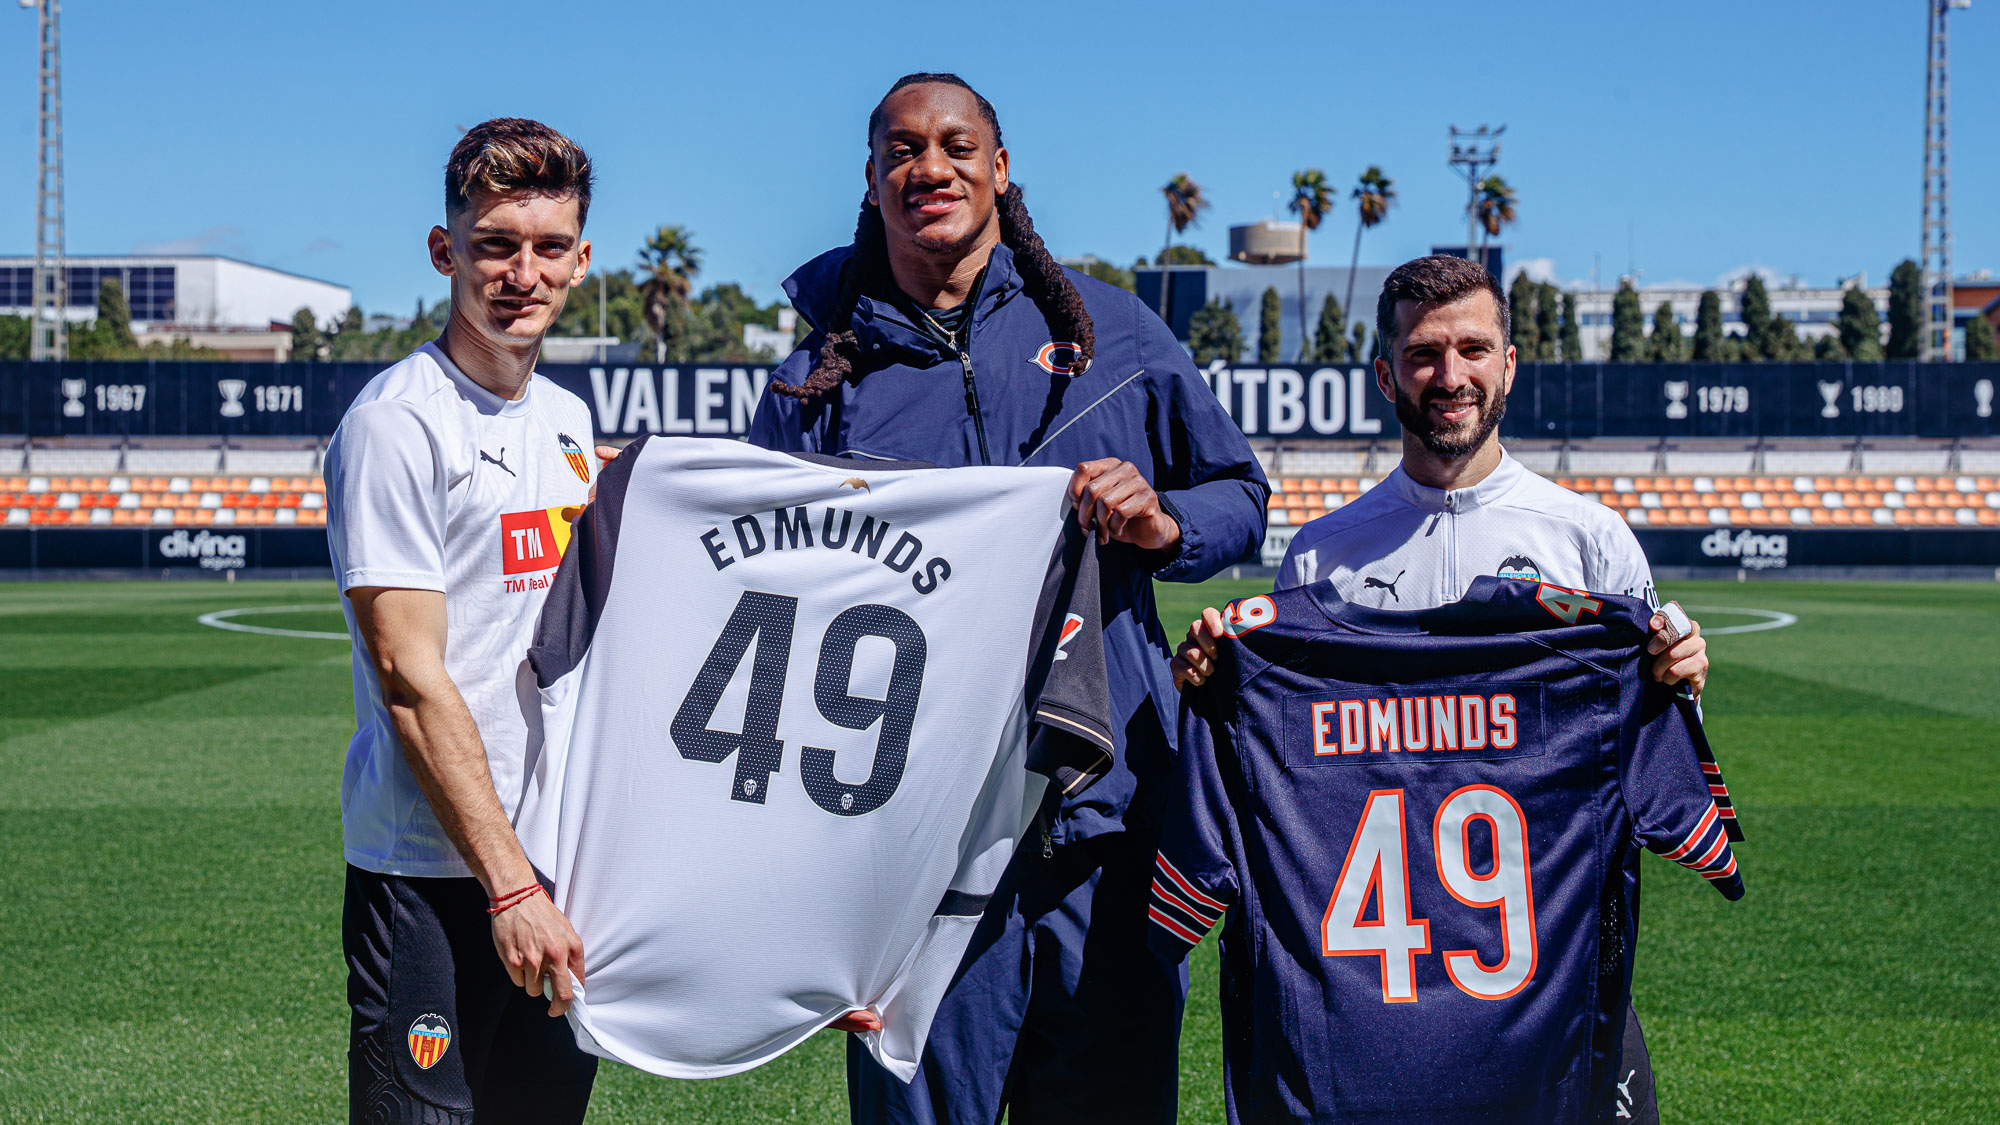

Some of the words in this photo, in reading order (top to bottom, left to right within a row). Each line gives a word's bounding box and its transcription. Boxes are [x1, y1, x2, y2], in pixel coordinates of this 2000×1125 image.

[95, 385, 146, 411] 1967
[254, 385, 302, 412] 1971
[1697, 386, 1749, 412] 1979
[159, 529, 246, 558] divina
[510, 527, 545, 561] TM
[699, 506, 952, 595] EDMUNDS
[1701, 528, 1788, 557] divina
[504, 579, 525, 593] TM
[529, 575, 549, 591] Real
[1220, 594, 1277, 639] 9
[1536, 582, 1603, 626] 4
[669, 590, 928, 818] 49
[1311, 694, 1518, 756] EDMUNDS
[1320, 783, 1539, 1003] 49
